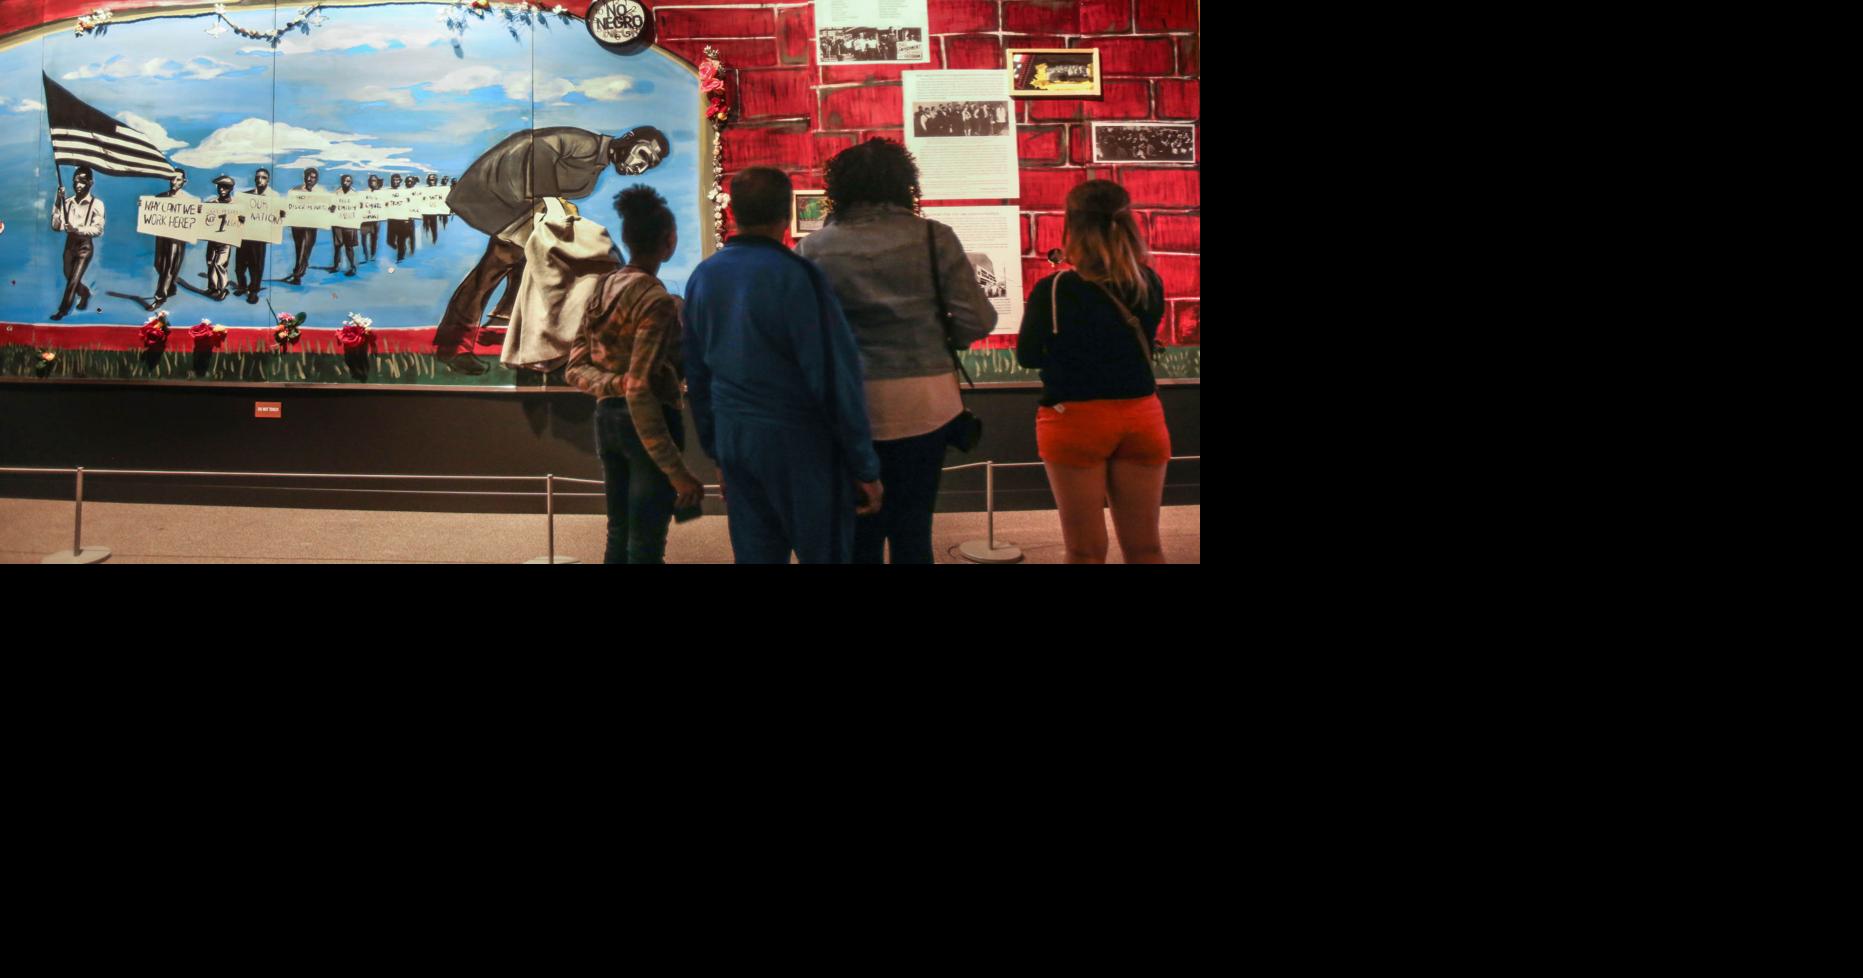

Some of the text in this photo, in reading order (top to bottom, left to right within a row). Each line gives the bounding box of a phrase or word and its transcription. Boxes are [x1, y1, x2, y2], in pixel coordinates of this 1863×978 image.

[606, 3, 628, 17] NO
[596, 15, 643, 30] NEGRO
[144, 200, 160, 211] WHY
[182, 204, 196, 215] WE
[143, 214, 197, 229] WORK HERE?
